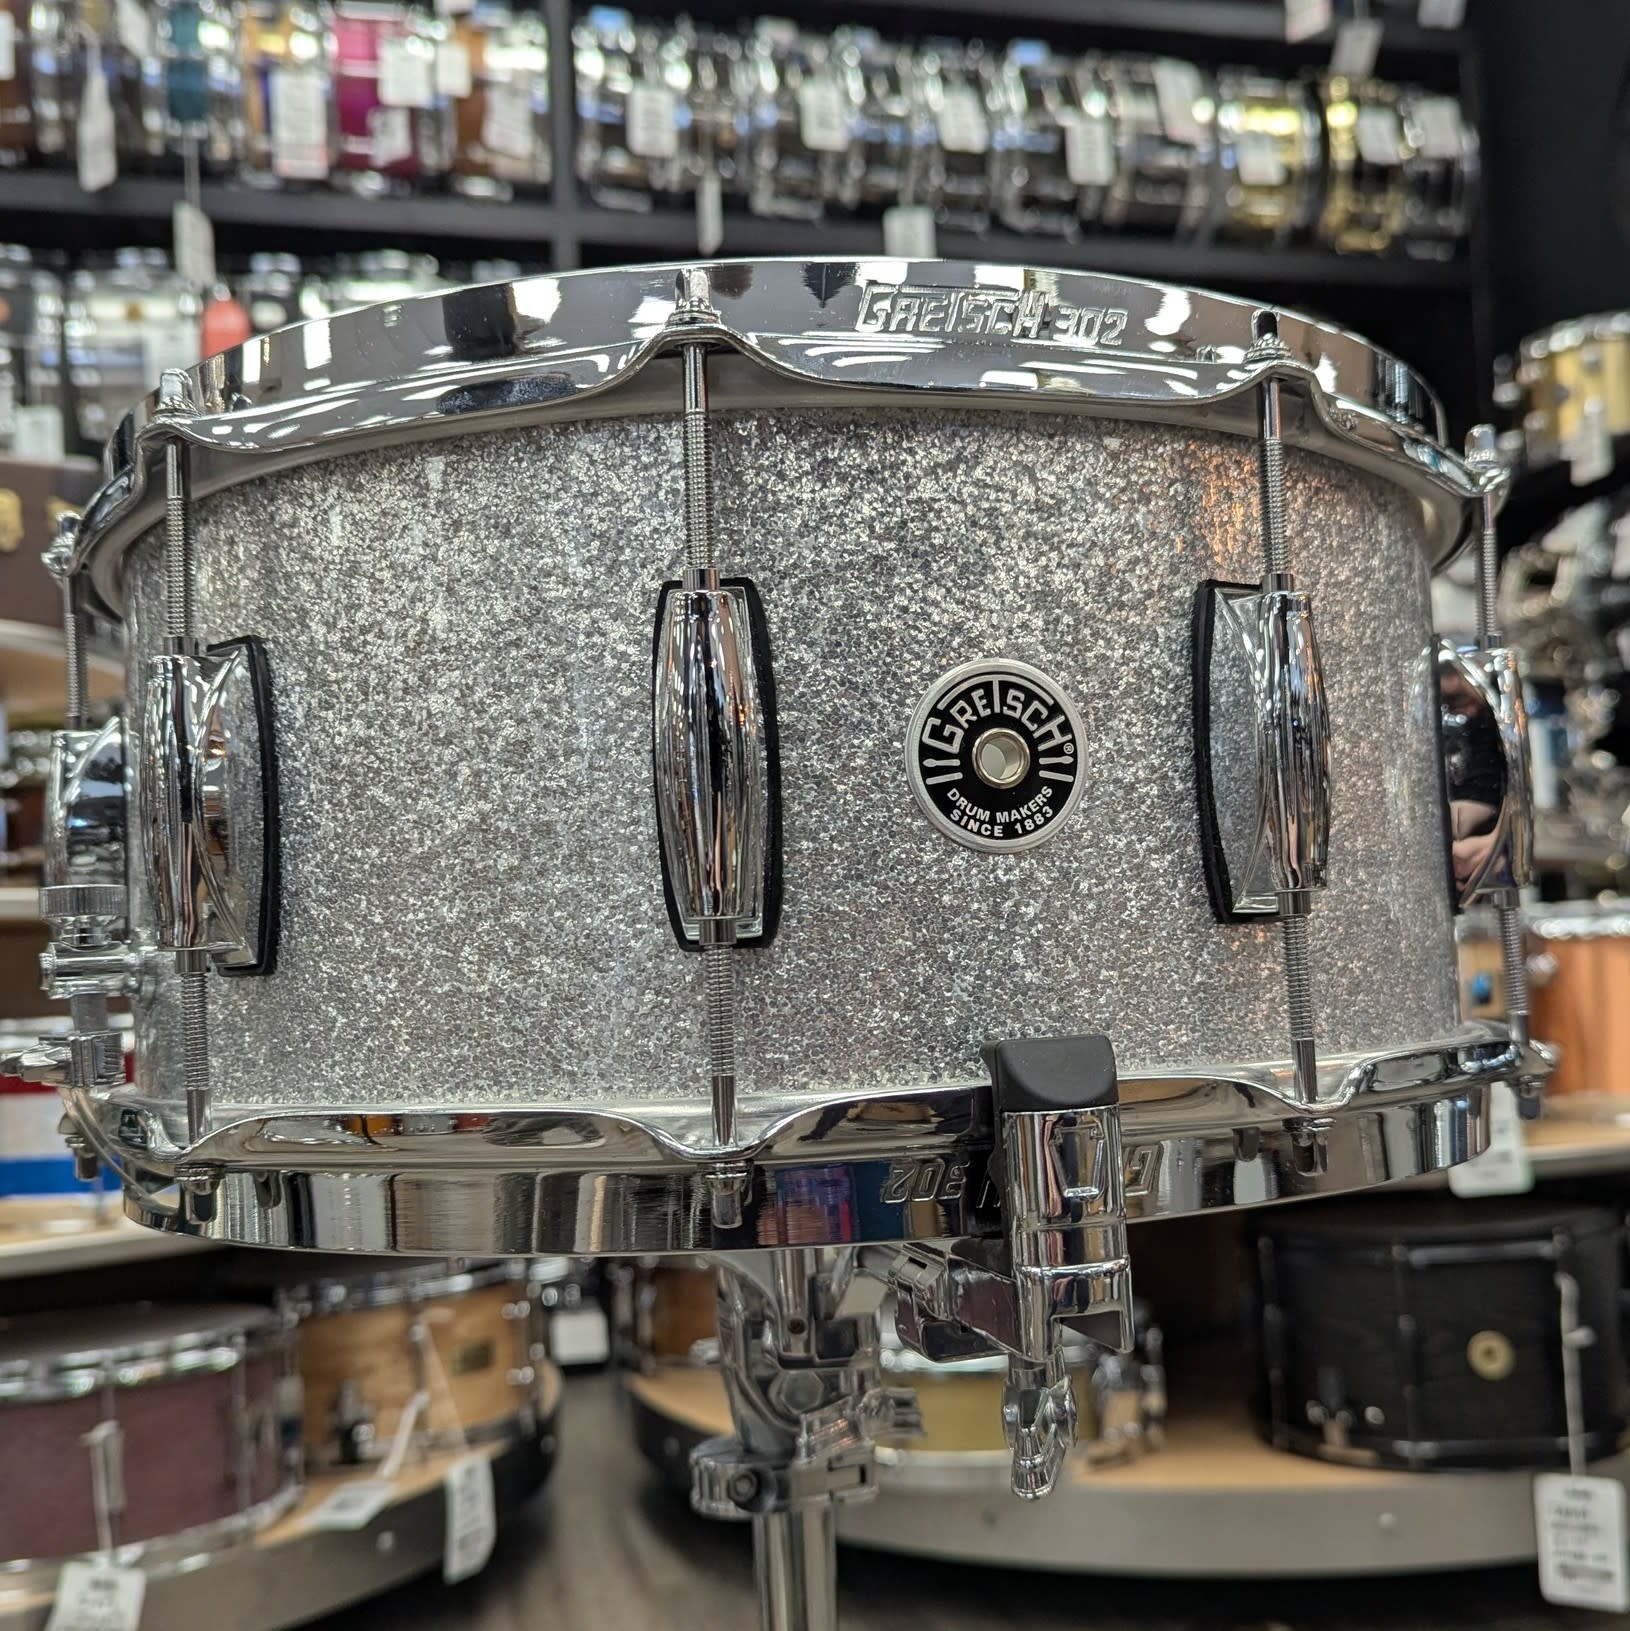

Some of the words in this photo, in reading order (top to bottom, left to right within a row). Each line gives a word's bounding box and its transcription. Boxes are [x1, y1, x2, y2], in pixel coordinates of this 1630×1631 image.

[855, 284, 1049, 338] GRETSCH
[1055, 305, 1129, 346] 302
[947, 787, 991, 822] DRUM
[996, 785, 1053, 824] MAKERS
[950, 809, 1004, 837] SINCE
[1014, 806, 1053, 834] 1883
